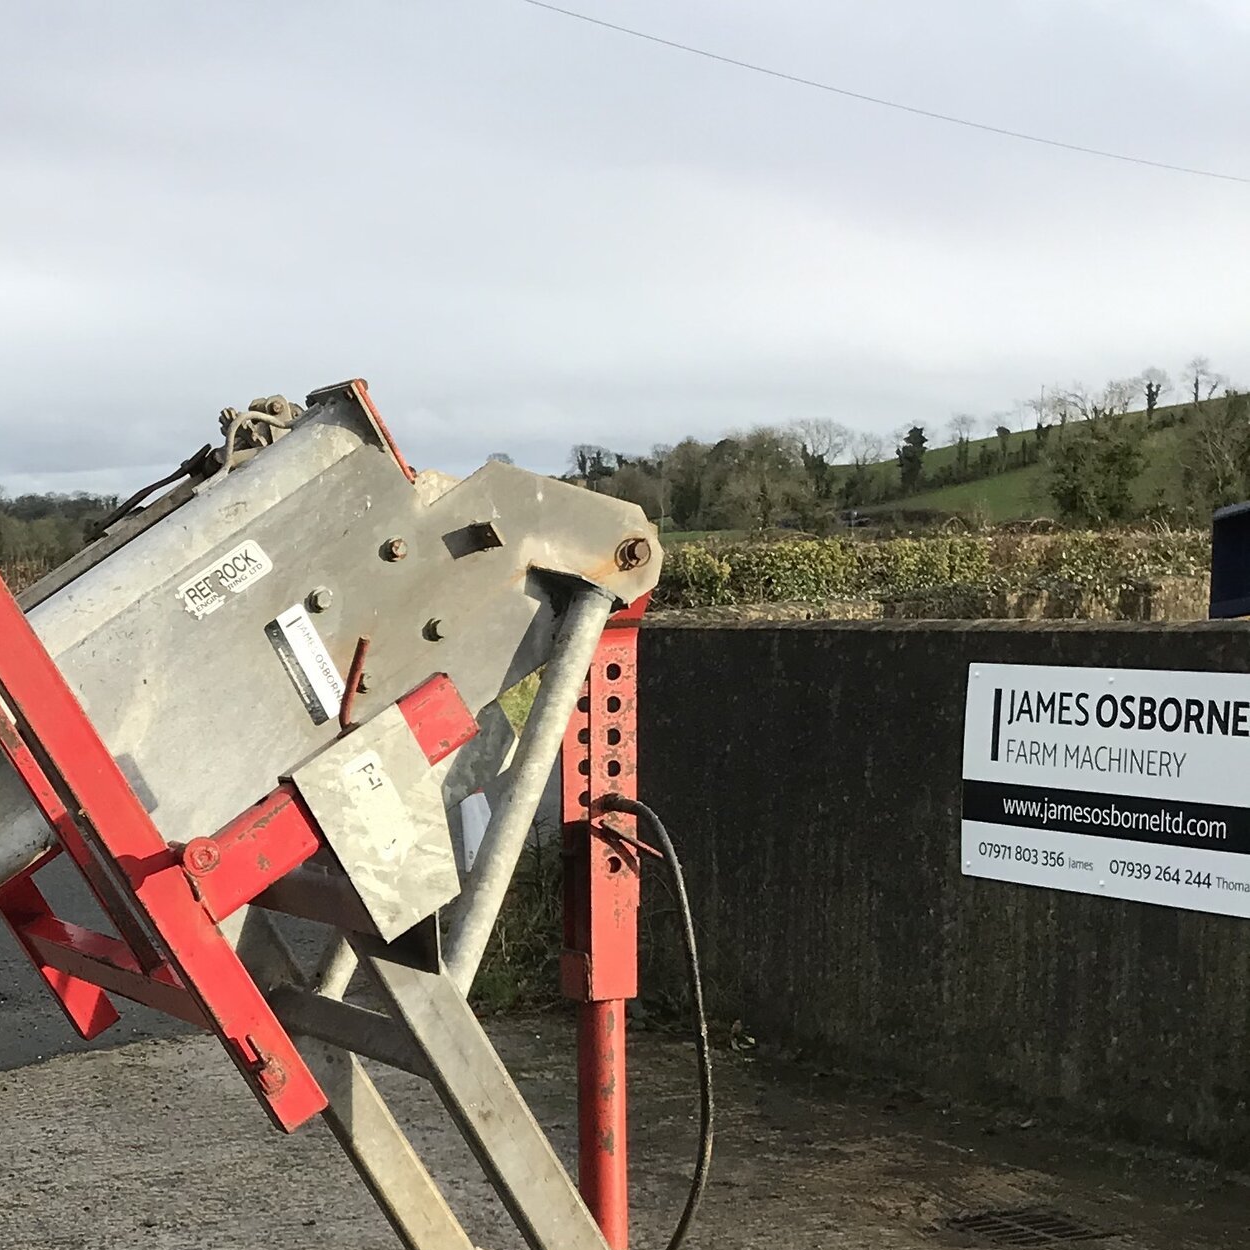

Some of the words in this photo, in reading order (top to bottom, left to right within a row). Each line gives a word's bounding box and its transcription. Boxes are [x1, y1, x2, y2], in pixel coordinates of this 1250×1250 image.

[195, 574, 248, 612] ENGINRING
[249, 563, 263, 575] LTD
[1008, 689, 1090, 726] JAMES
[1095, 693, 1250, 737] OSBORNE
[1006, 739, 1057, 767] FARM
[1064, 743, 1187, 778] MACHINERY
[1003, 797, 1227, 840] www.jamesosborneltd.com
[978, 841, 1012, 860] 07971
[1014, 845, 1038, 865] 803
[1041, 850, 1065, 868] 356
[1109, 859, 1152, 880] 07939
[1154, 865, 1181, 885] 264
[1184, 869, 1212, 889] 244
